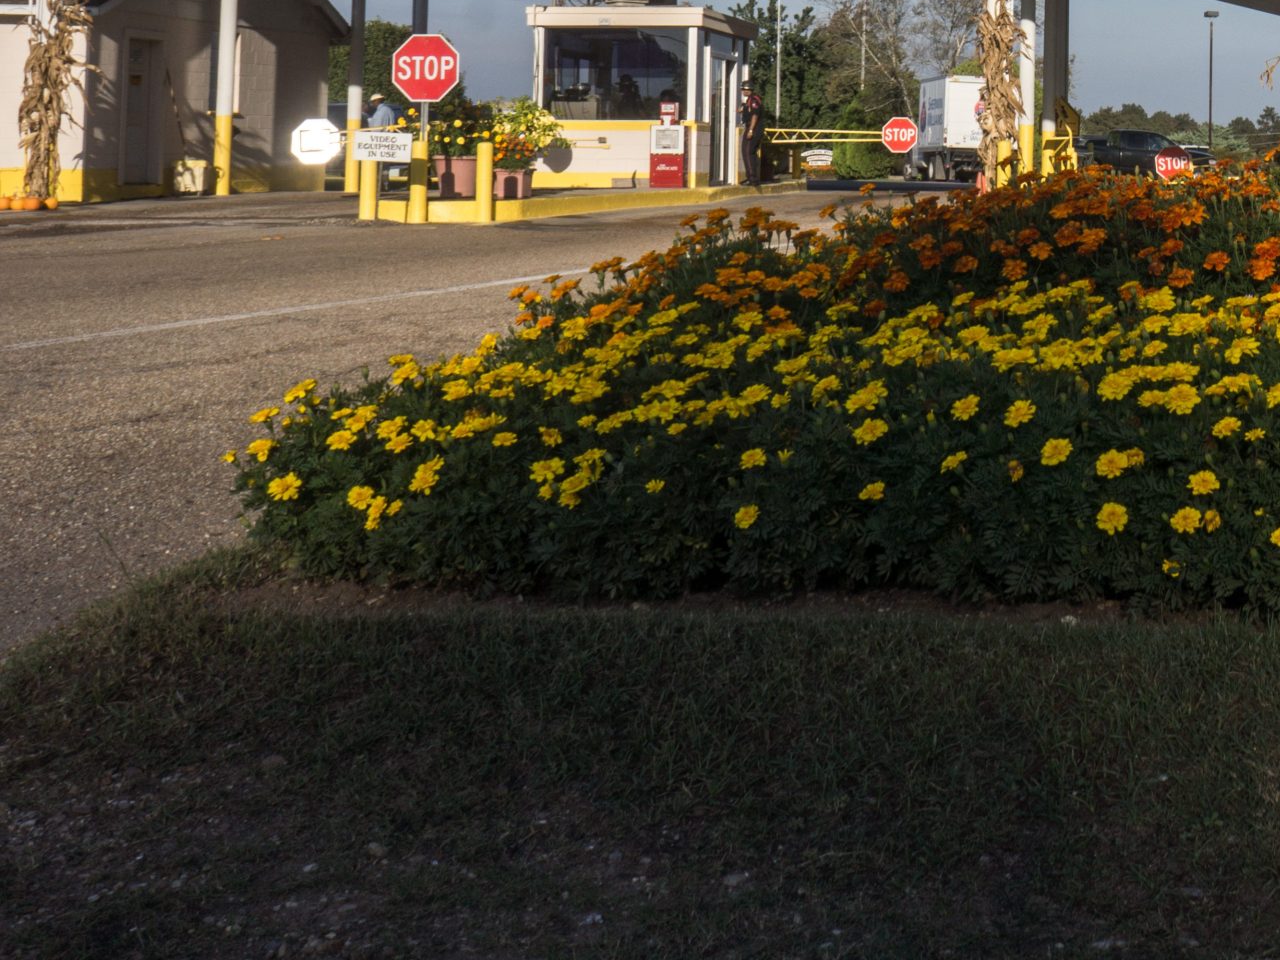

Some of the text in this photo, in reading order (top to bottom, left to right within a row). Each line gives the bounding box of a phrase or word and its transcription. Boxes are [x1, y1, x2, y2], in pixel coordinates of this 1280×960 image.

[398, 55, 455, 80] STOP
[370, 135, 397, 143] VIDEO
[885, 128, 915, 141] STOP
[357, 143, 408, 151] EQUIPMENT
[1158, 157, 1188, 171] STOP
